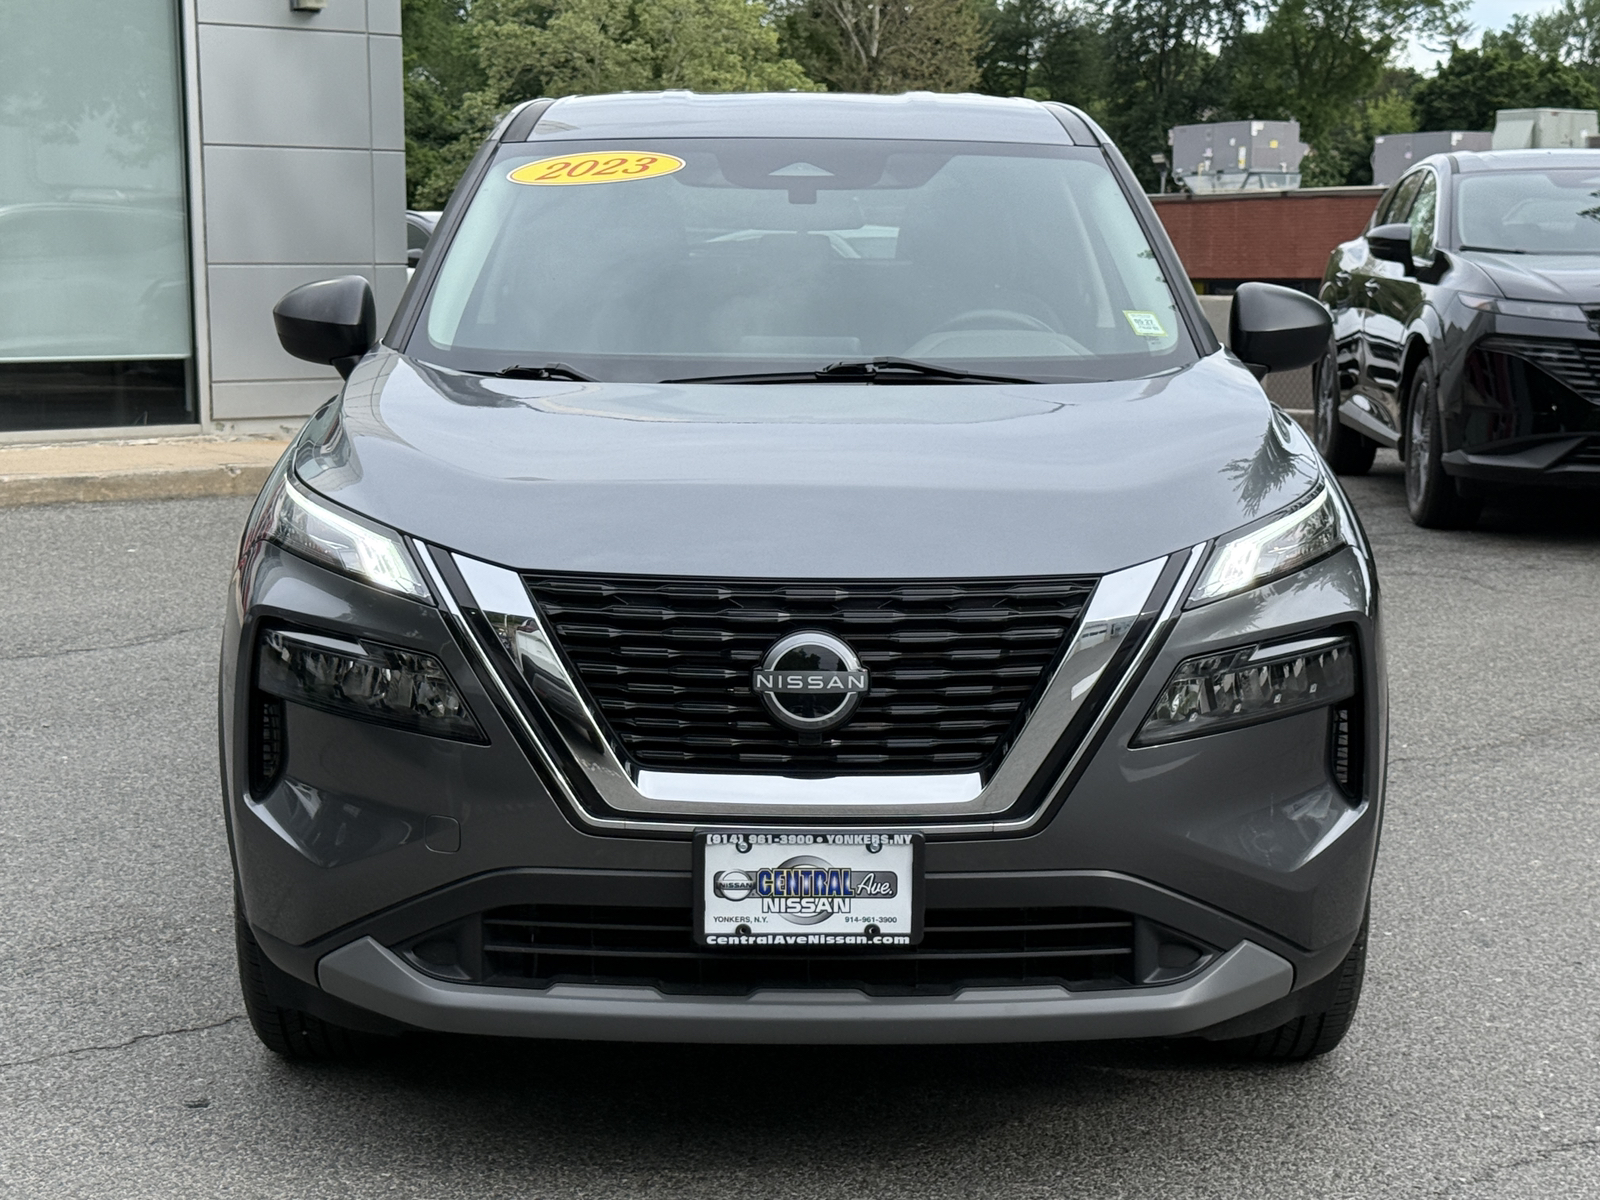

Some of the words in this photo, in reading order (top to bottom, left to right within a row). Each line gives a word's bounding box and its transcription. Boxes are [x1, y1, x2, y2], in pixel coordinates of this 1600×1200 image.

[534, 157, 658, 181] 2023
[756, 674, 865, 689] NISSAN
[706, 834, 744, 845] (914)
[748, 834, 814, 845] 961-3900
[756, 868, 854, 898] CENTRAL
[856, 872, 893, 894] Ave.
[761, 897, 851, 914] NISSAN
[713, 915, 753, 924] YONKERS,
[753, 915, 769, 923] N.Y.
[706, 935, 910, 945] CentralAveNissan.com
